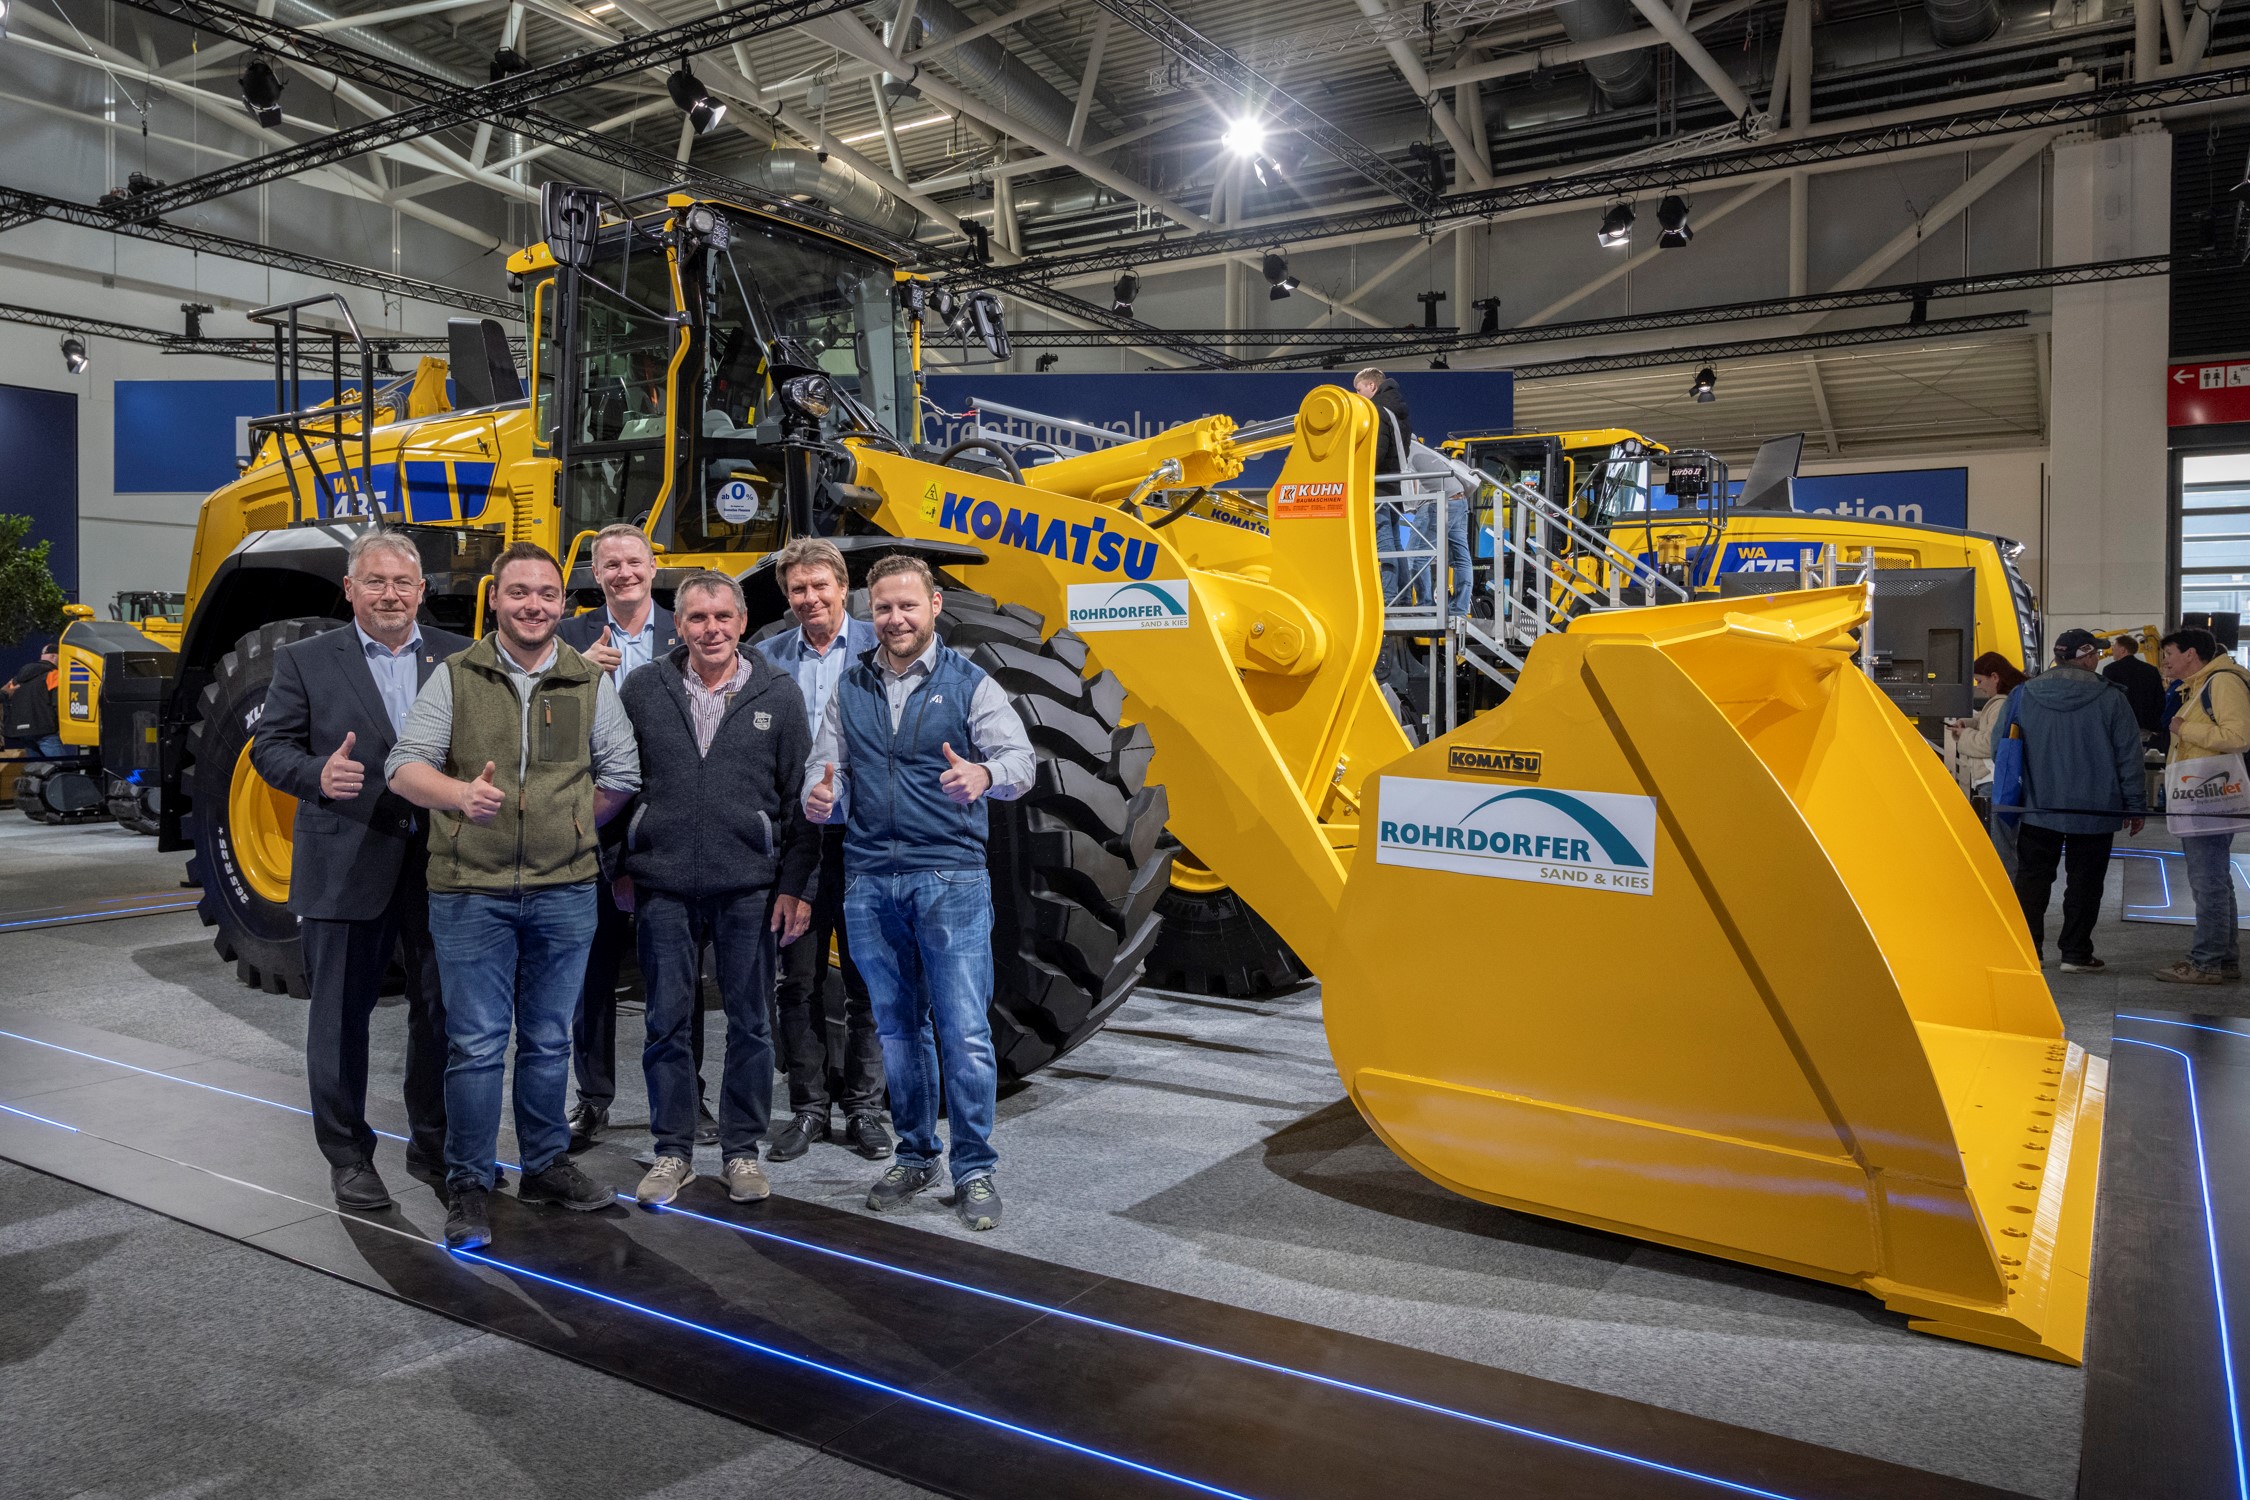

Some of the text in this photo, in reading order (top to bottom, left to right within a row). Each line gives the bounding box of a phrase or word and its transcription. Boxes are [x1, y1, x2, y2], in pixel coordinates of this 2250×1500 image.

[732, 484, 745, 500] 0
[1298, 483, 1344, 497] KUHN
[1793, 498, 1923, 523] tion
[939, 491, 1159, 581] KOMATSU
[1737, 546, 1768, 559] WA
[1737, 559, 1795, 573] 475
[1069, 605, 1163, 621] ROHRDORFER
[1141, 620, 1162, 628] SAND
[245, 703, 265, 730] XL
[1451, 751, 1539, 771] KOMATSU
[1381, 820, 1592, 863] ROHRDORFER
[218, 838, 250, 904] 26.5 R 25
[1540, 867, 1649, 889] SAND & KIES
